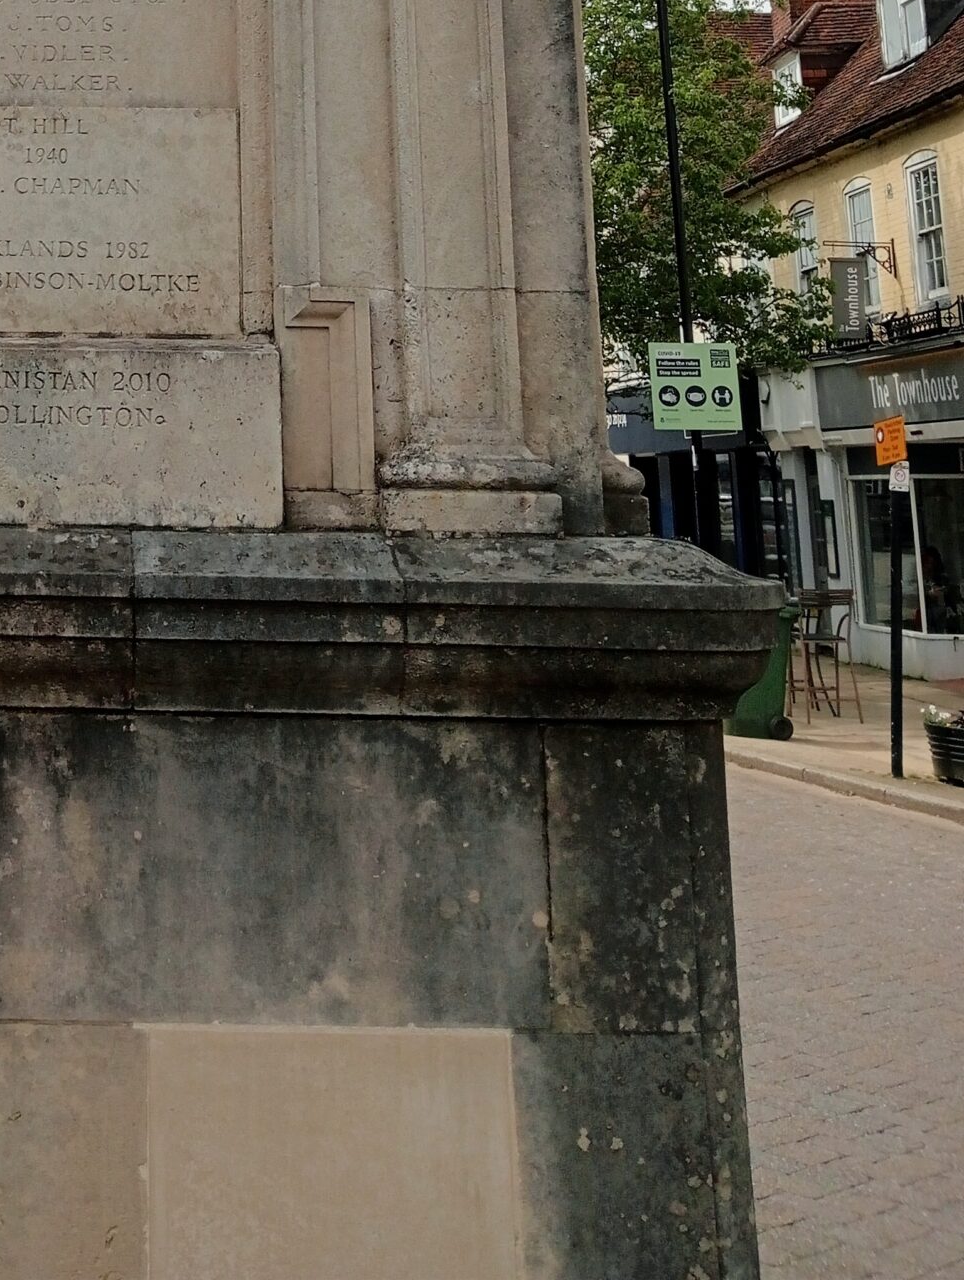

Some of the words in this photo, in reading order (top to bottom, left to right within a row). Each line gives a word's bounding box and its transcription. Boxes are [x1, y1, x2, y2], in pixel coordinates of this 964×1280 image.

[33, 118, 89, 135] HILL
[25, 147, 68, 164] 1940
[14, 176, 141, 195] CHAPMAN
[106, 240, 150, 259] 1982
[844, 267, 860, 332] Townhouse
[112, 371, 172, 393] 2010
[868, 375, 891, 409] The
[892, 368, 960, 406] Townhouse
